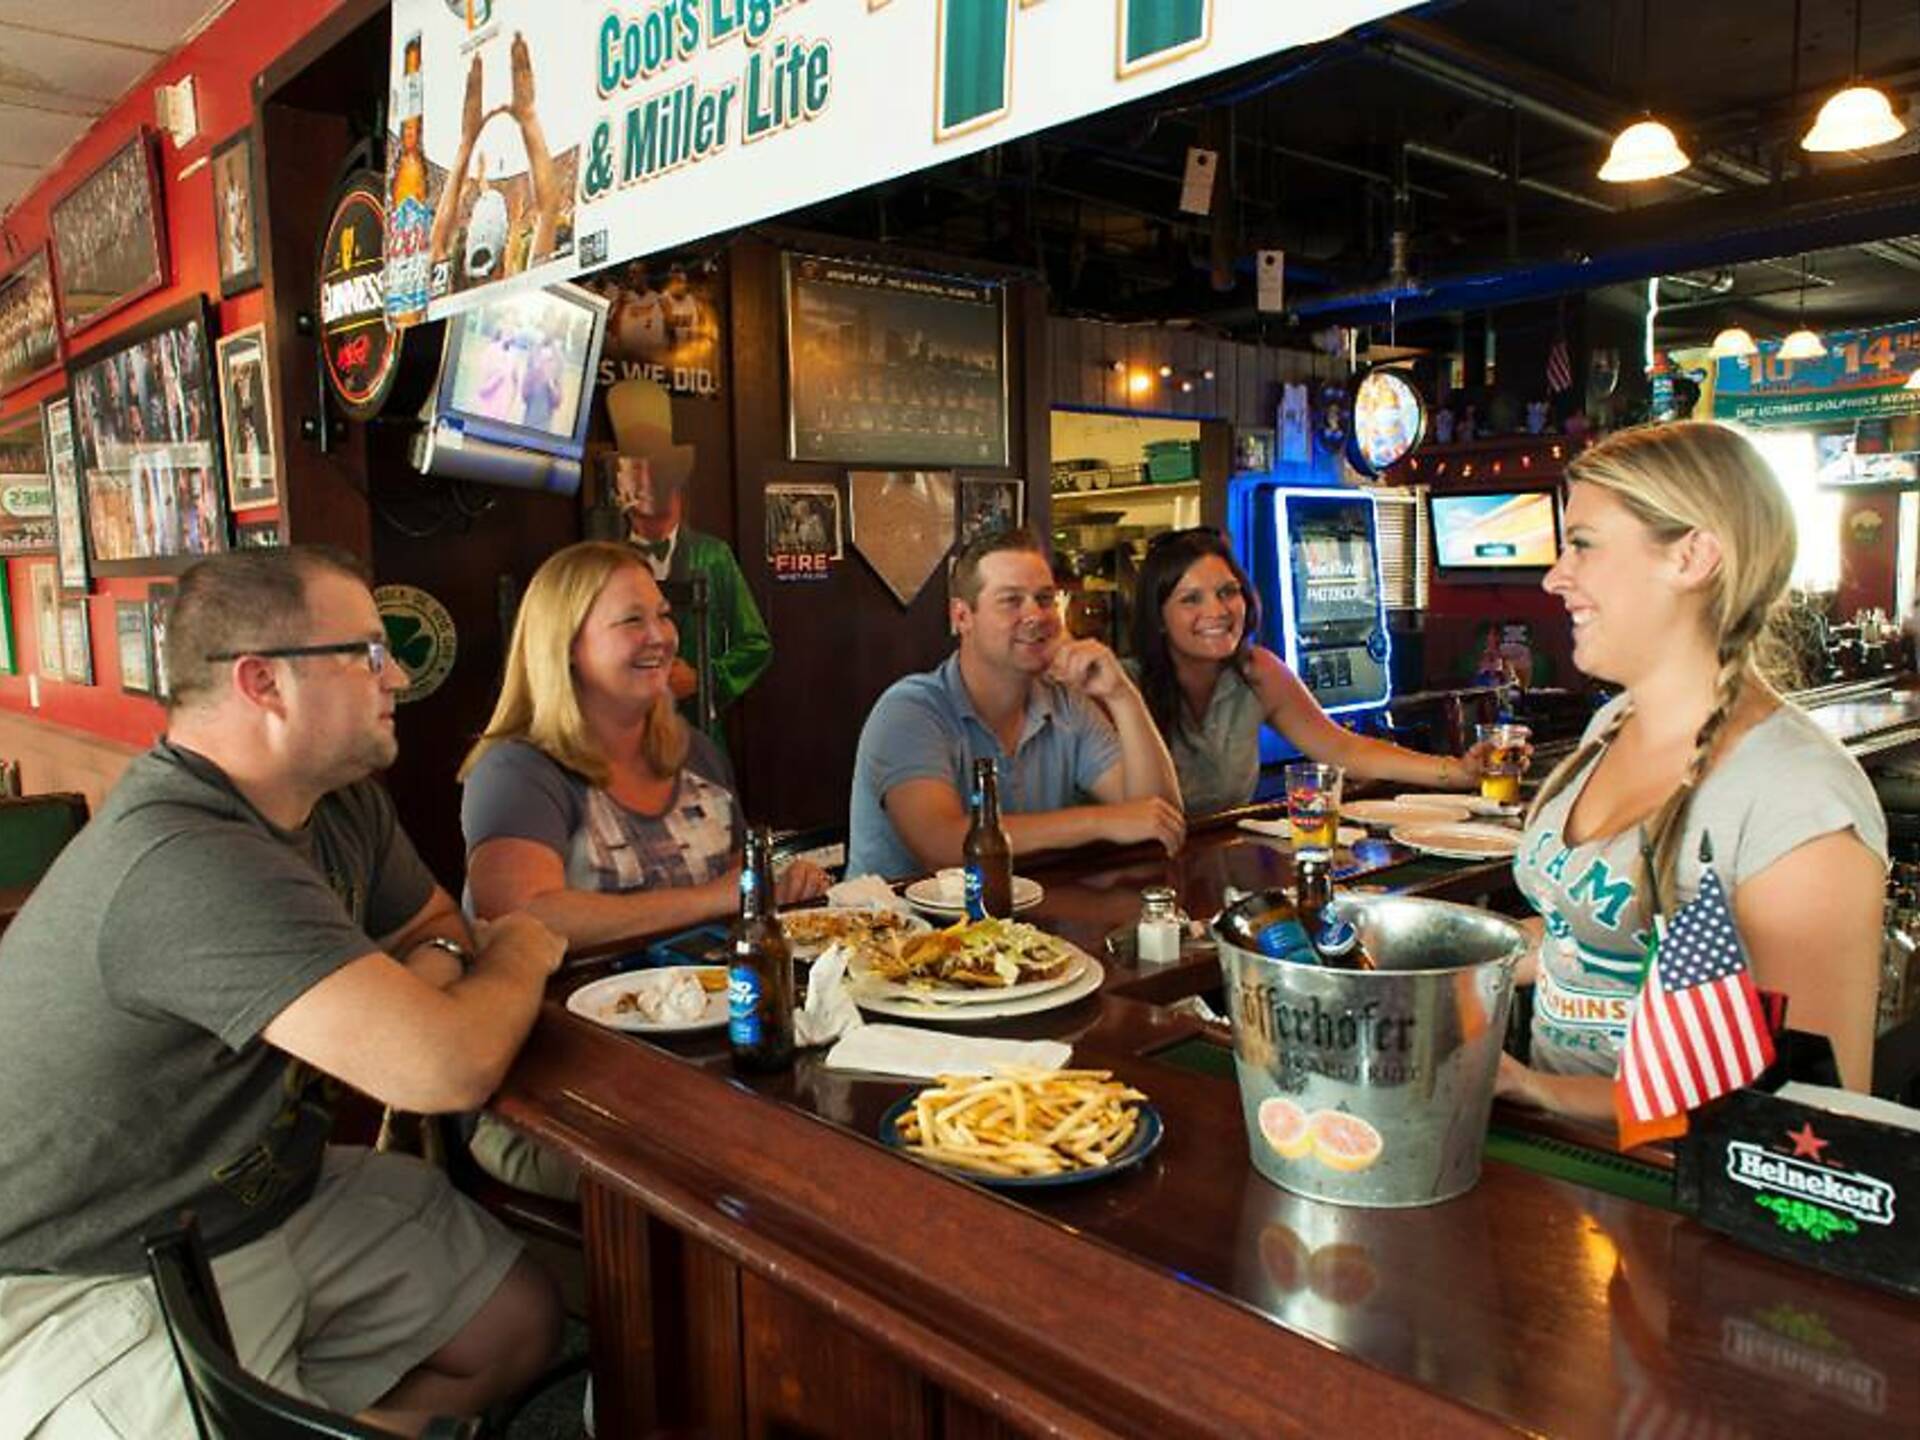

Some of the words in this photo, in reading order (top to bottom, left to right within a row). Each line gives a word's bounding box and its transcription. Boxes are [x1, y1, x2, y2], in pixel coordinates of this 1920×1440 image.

[597, 0, 701, 98] Coors
[581, 120, 615, 203] &
[618, 78, 738, 190] Miller
[741, 37, 832, 146] Lite
[776, 553, 828, 572] FIRE
[1738, 1151, 1883, 1214] Heineken
